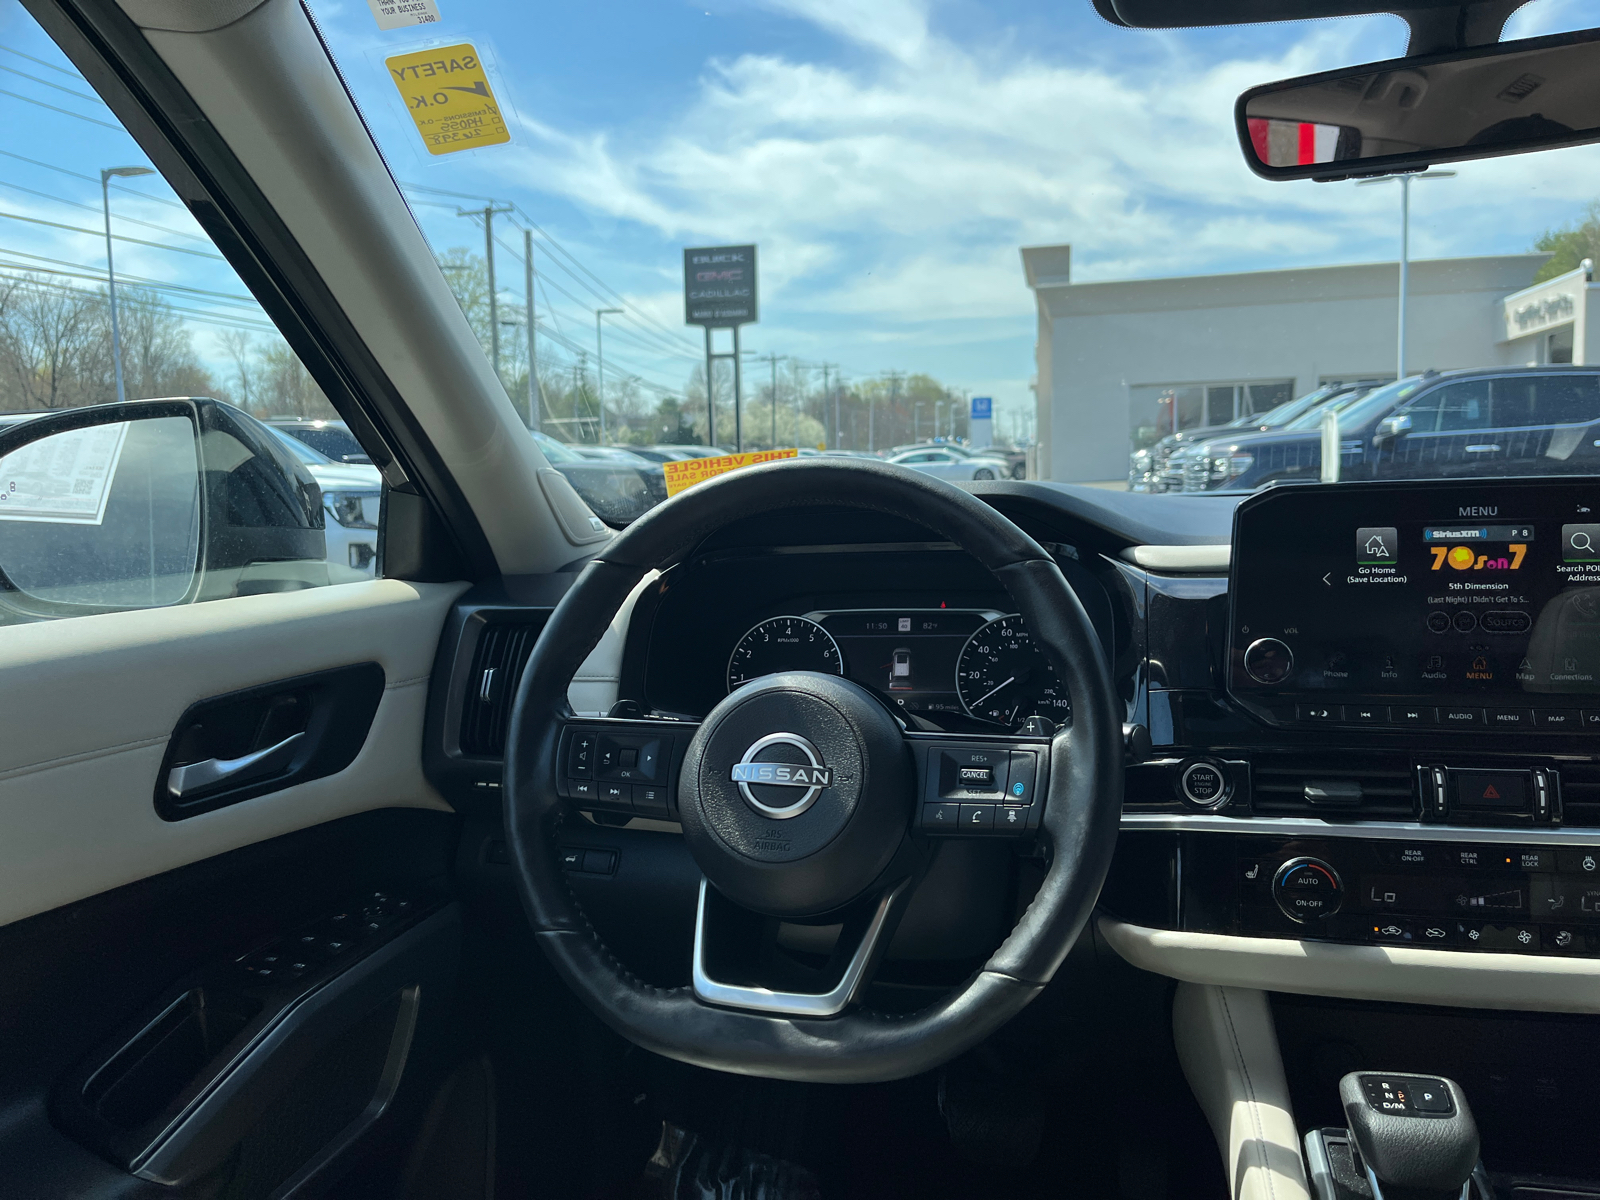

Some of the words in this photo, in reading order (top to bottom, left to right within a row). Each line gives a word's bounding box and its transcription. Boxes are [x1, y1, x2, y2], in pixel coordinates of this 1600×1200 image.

[381, 6, 397, 15] YOUR
[397, 2, 427, 13] BUSINESS
[689, 289, 750, 299] CADILLAC
[1458, 506, 1498, 517] MENU
[1511, 529, 1518, 537] P
[1522, 529, 1529, 537] 8
[1556, 564, 1584, 572] Search
[1347, 575, 1368, 584] (Save
[1369, 575, 1408, 584] Location)
[1427, 596, 1445, 604] (Last
[1445, 596, 1468, 604] Night)
[1487, 616, 1525, 626] Source
[866, 622, 888, 630] 11:50
[785, 627, 792, 635] 4
[1001, 628, 1013, 637] 60
[763, 634, 769, 642] 3
[808, 634, 815, 642] 5
[746, 650, 752, 658] 2
[823, 650, 830, 658] 6
[978, 646, 990, 654] 40
[968, 671, 980, 679] 20
[1323, 670, 1349, 678] Phone
[1421, 671, 1447, 679] Audio
[1466, 672, 1493, 680] MENU
[1515, 673, 1535, 681] Map
[1550, 673, 1593, 681] Connections
[1052, 700, 1068, 708] 140
[733, 766, 829, 785] NISSAN
[961, 771, 988, 779] CANCEL
[765, 829, 782, 838] SRS
[753, 841, 791, 852] AIRBAG
[1297, 877, 1319, 885] AUTO
[1382, 1102, 1406, 1110] D/M
